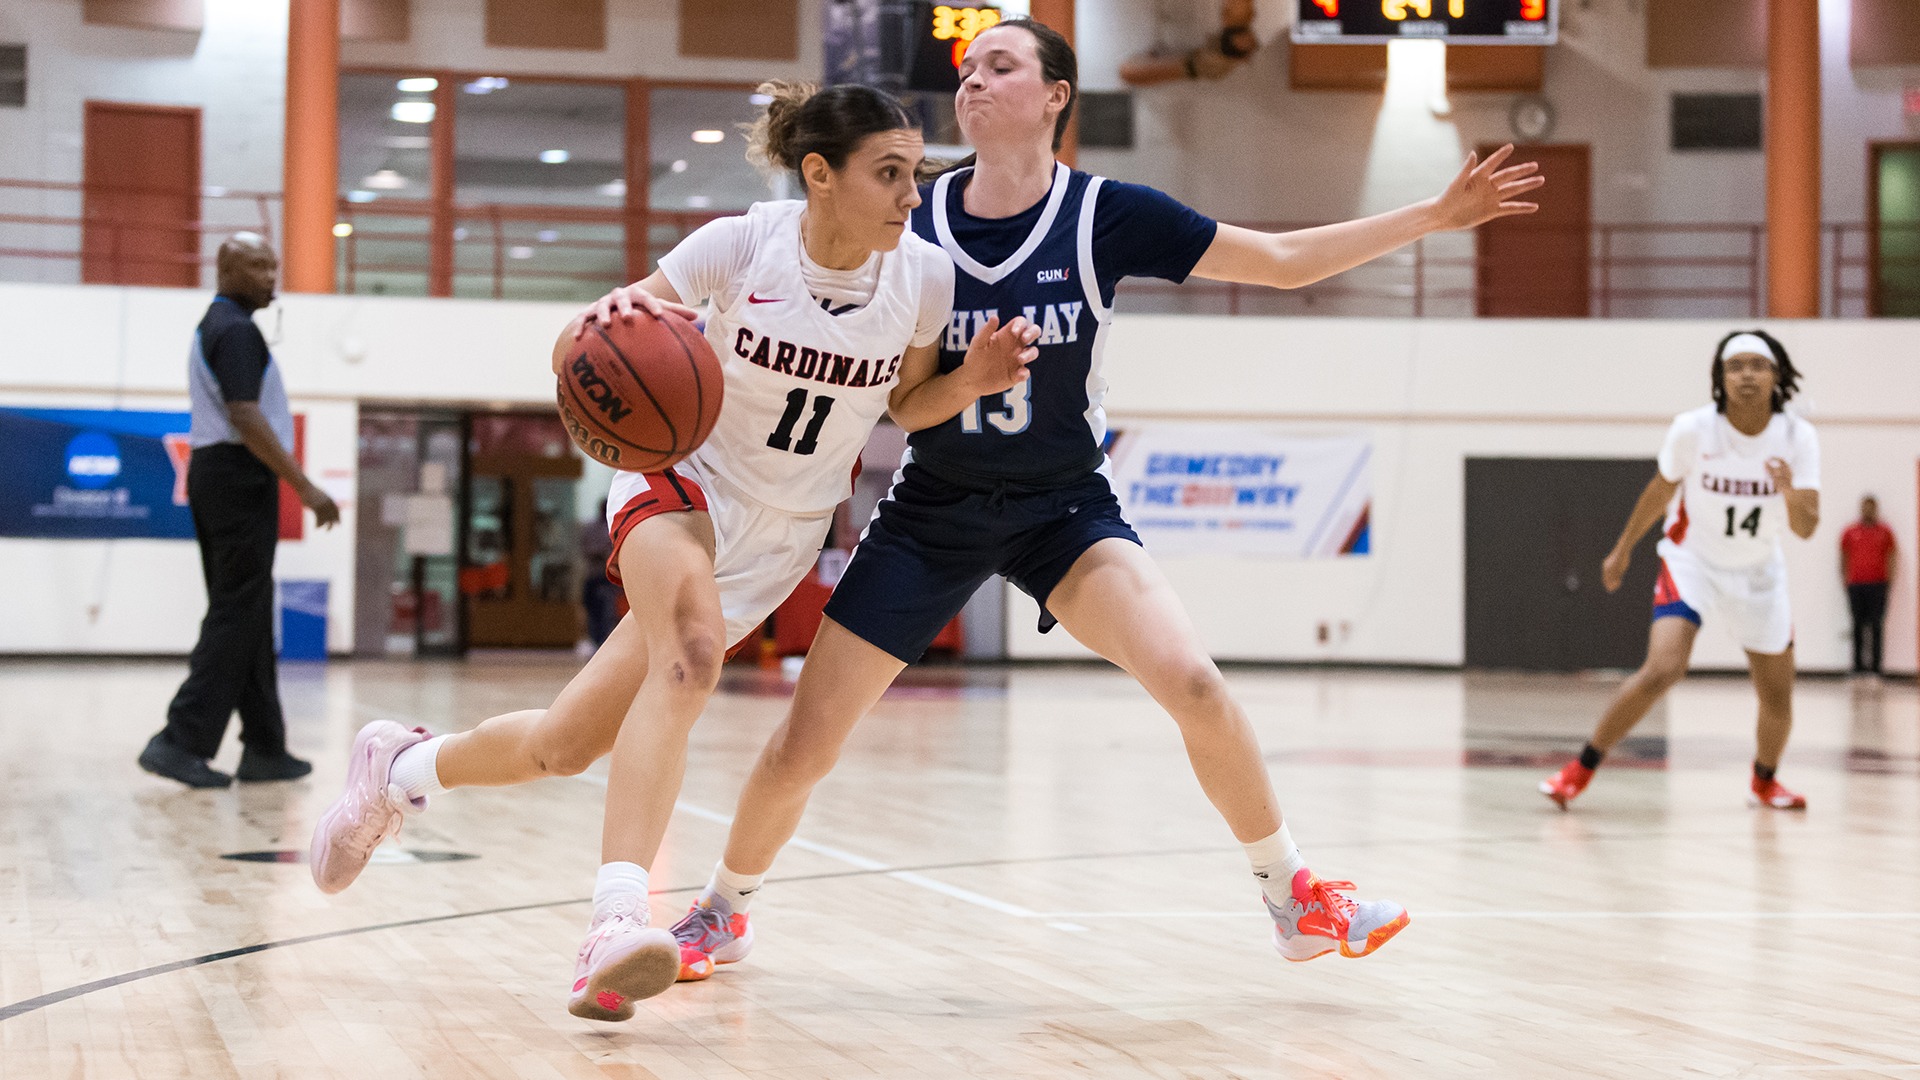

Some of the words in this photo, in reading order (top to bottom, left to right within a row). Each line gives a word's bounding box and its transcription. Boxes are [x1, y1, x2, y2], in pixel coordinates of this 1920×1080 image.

[572, 351, 632, 424] NCAA
[734, 327, 901, 388] CARDINALS
[766, 387, 836, 455] 11
[1702, 473, 1778, 496] CARDINA
[1725, 506, 1762, 537] 14
